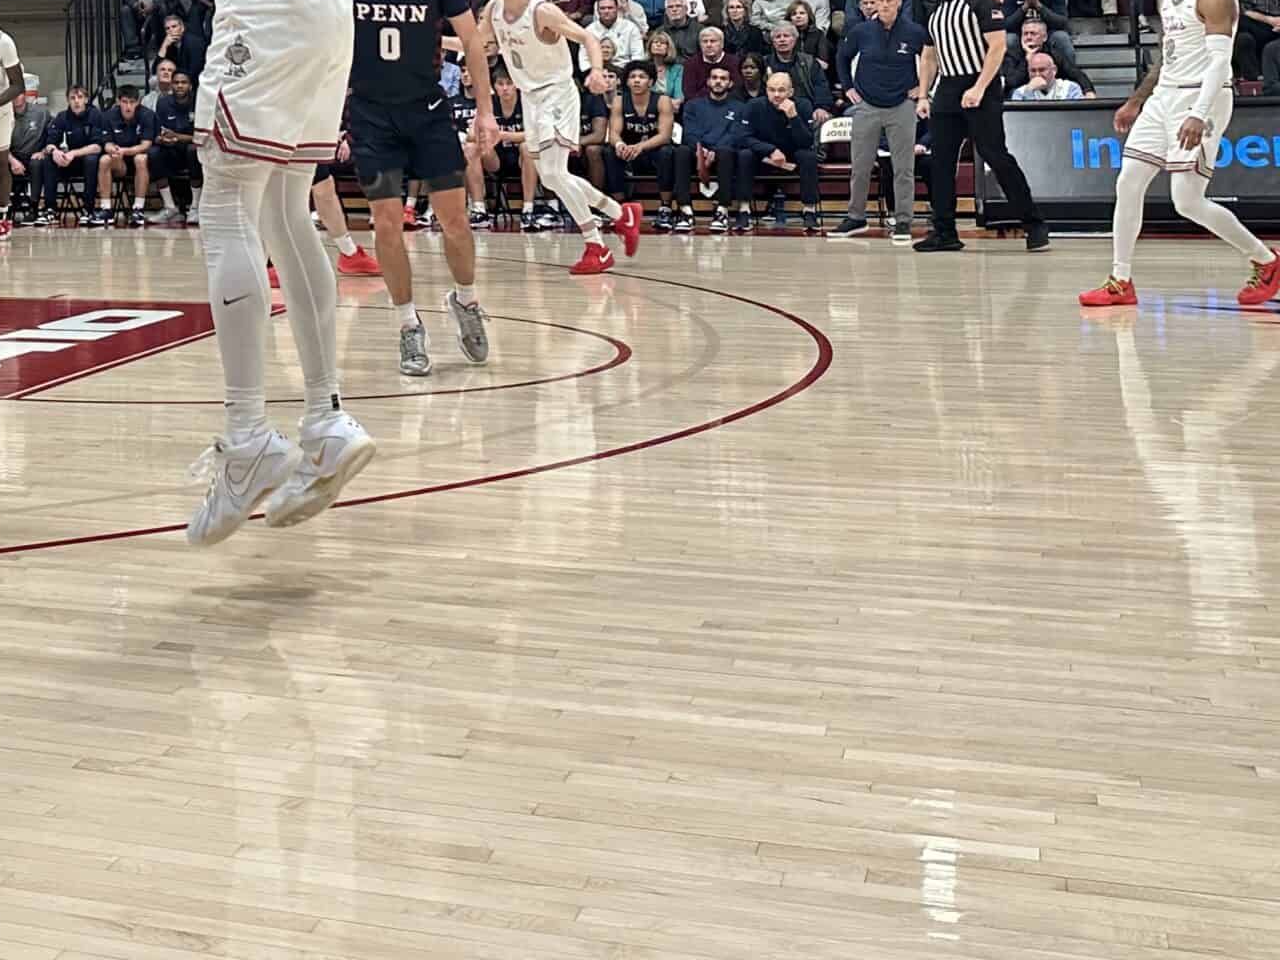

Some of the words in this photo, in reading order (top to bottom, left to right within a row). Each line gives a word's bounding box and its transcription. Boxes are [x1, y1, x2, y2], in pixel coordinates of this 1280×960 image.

[355, 3, 429, 23] PENN
[379, 27, 401, 61] 0
[454, 109, 477, 119] PEN
